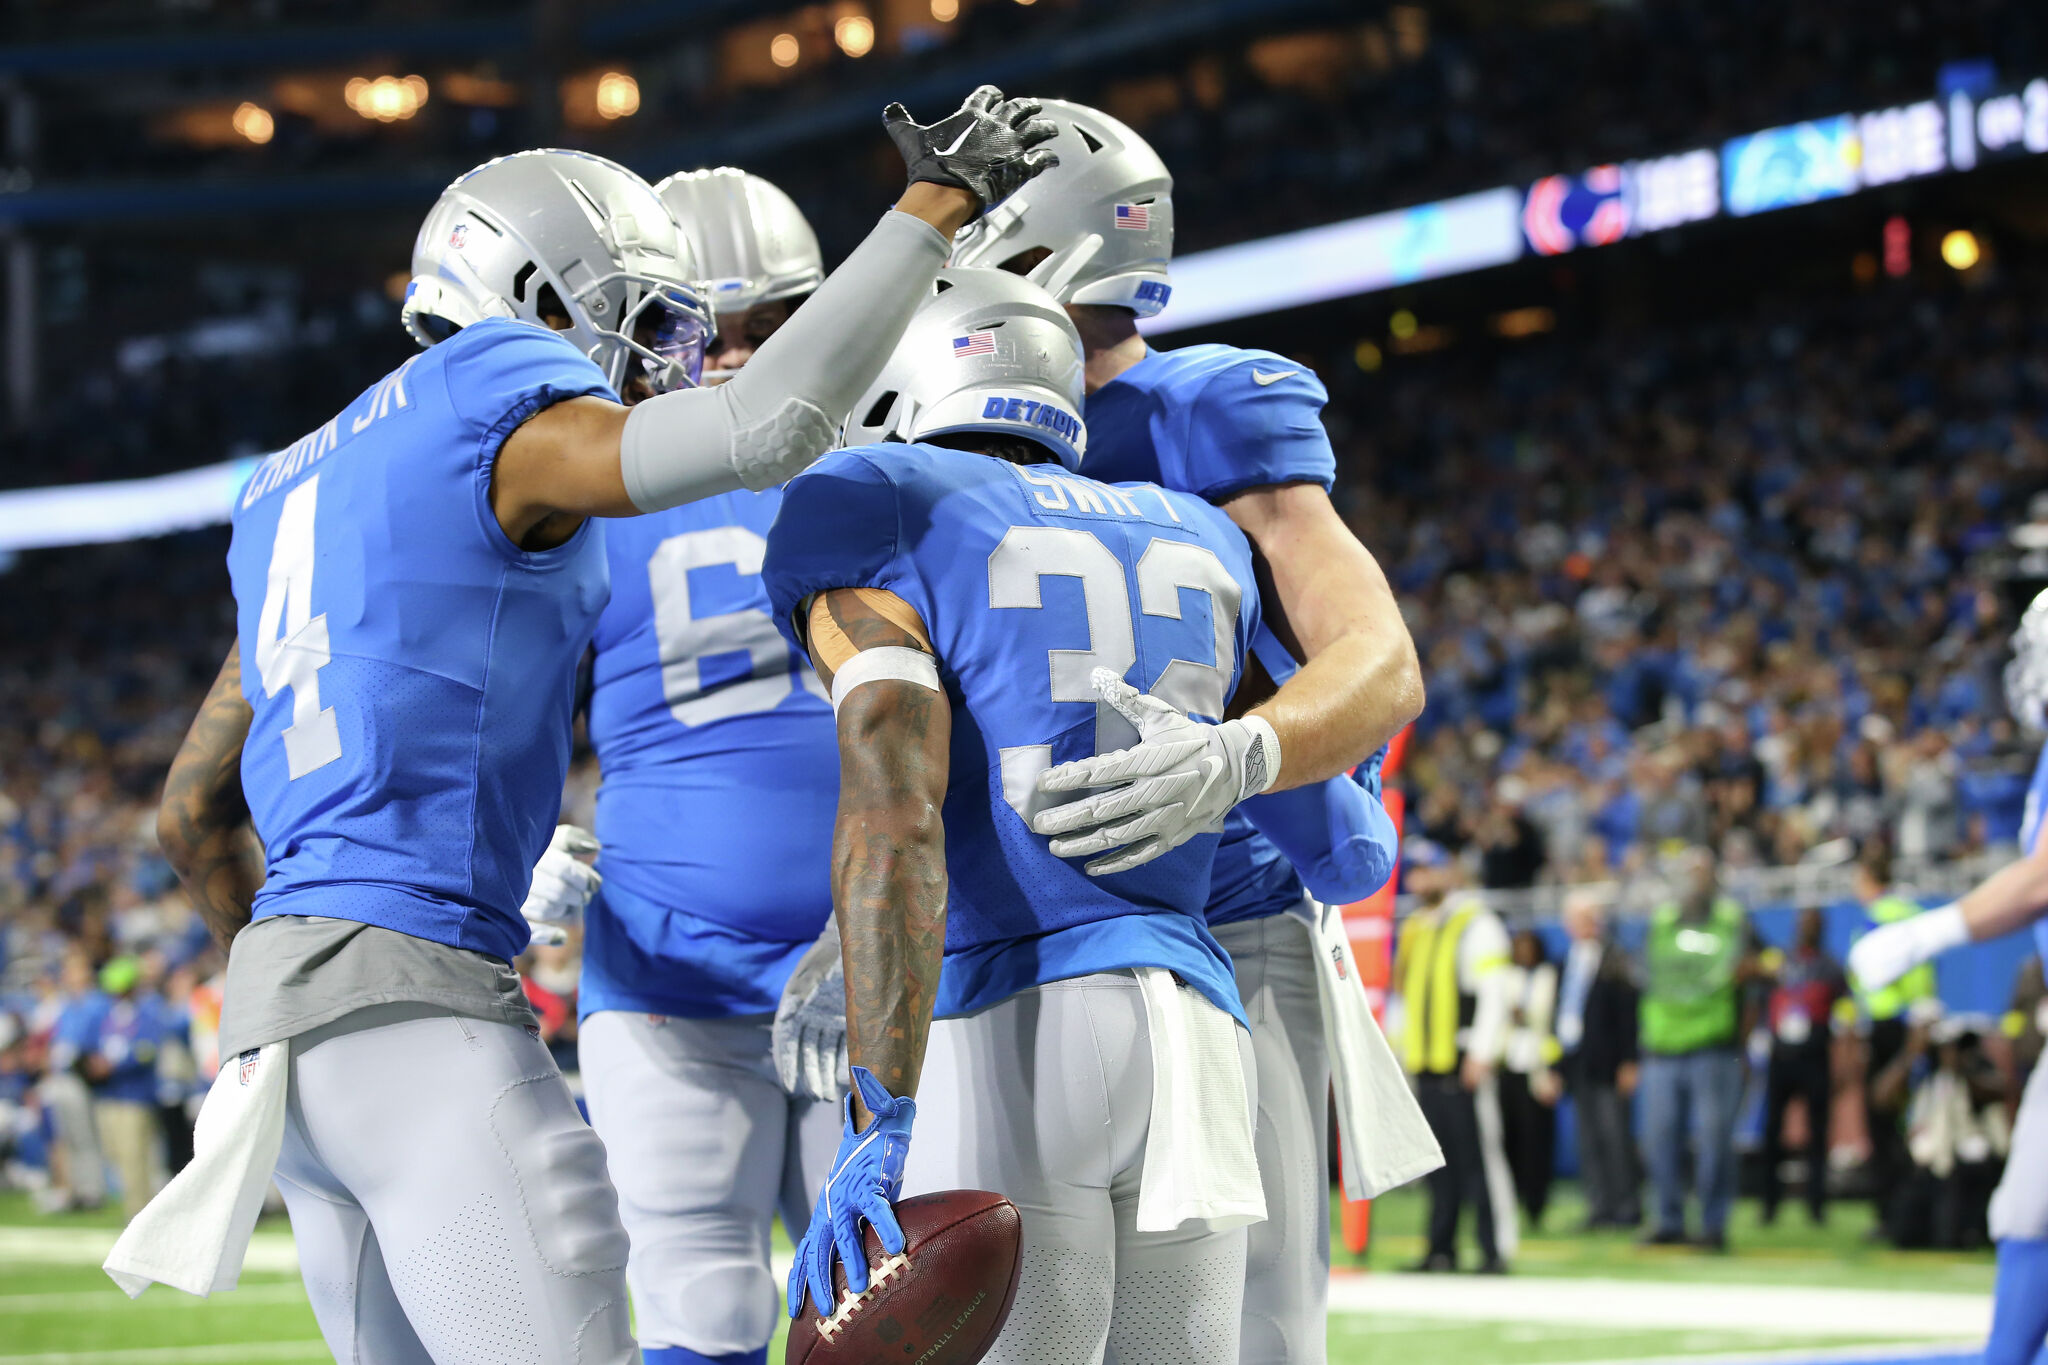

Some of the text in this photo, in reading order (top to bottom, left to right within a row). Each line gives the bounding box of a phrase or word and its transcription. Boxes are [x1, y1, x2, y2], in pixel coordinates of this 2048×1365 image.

[982, 396, 1083, 443] DETROIT
[1010, 461, 1182, 523] SWIFT
[255, 472, 342, 782] 4
[988, 525, 1242, 834] 32
[953, 1289, 988, 1332] LEAGUE
